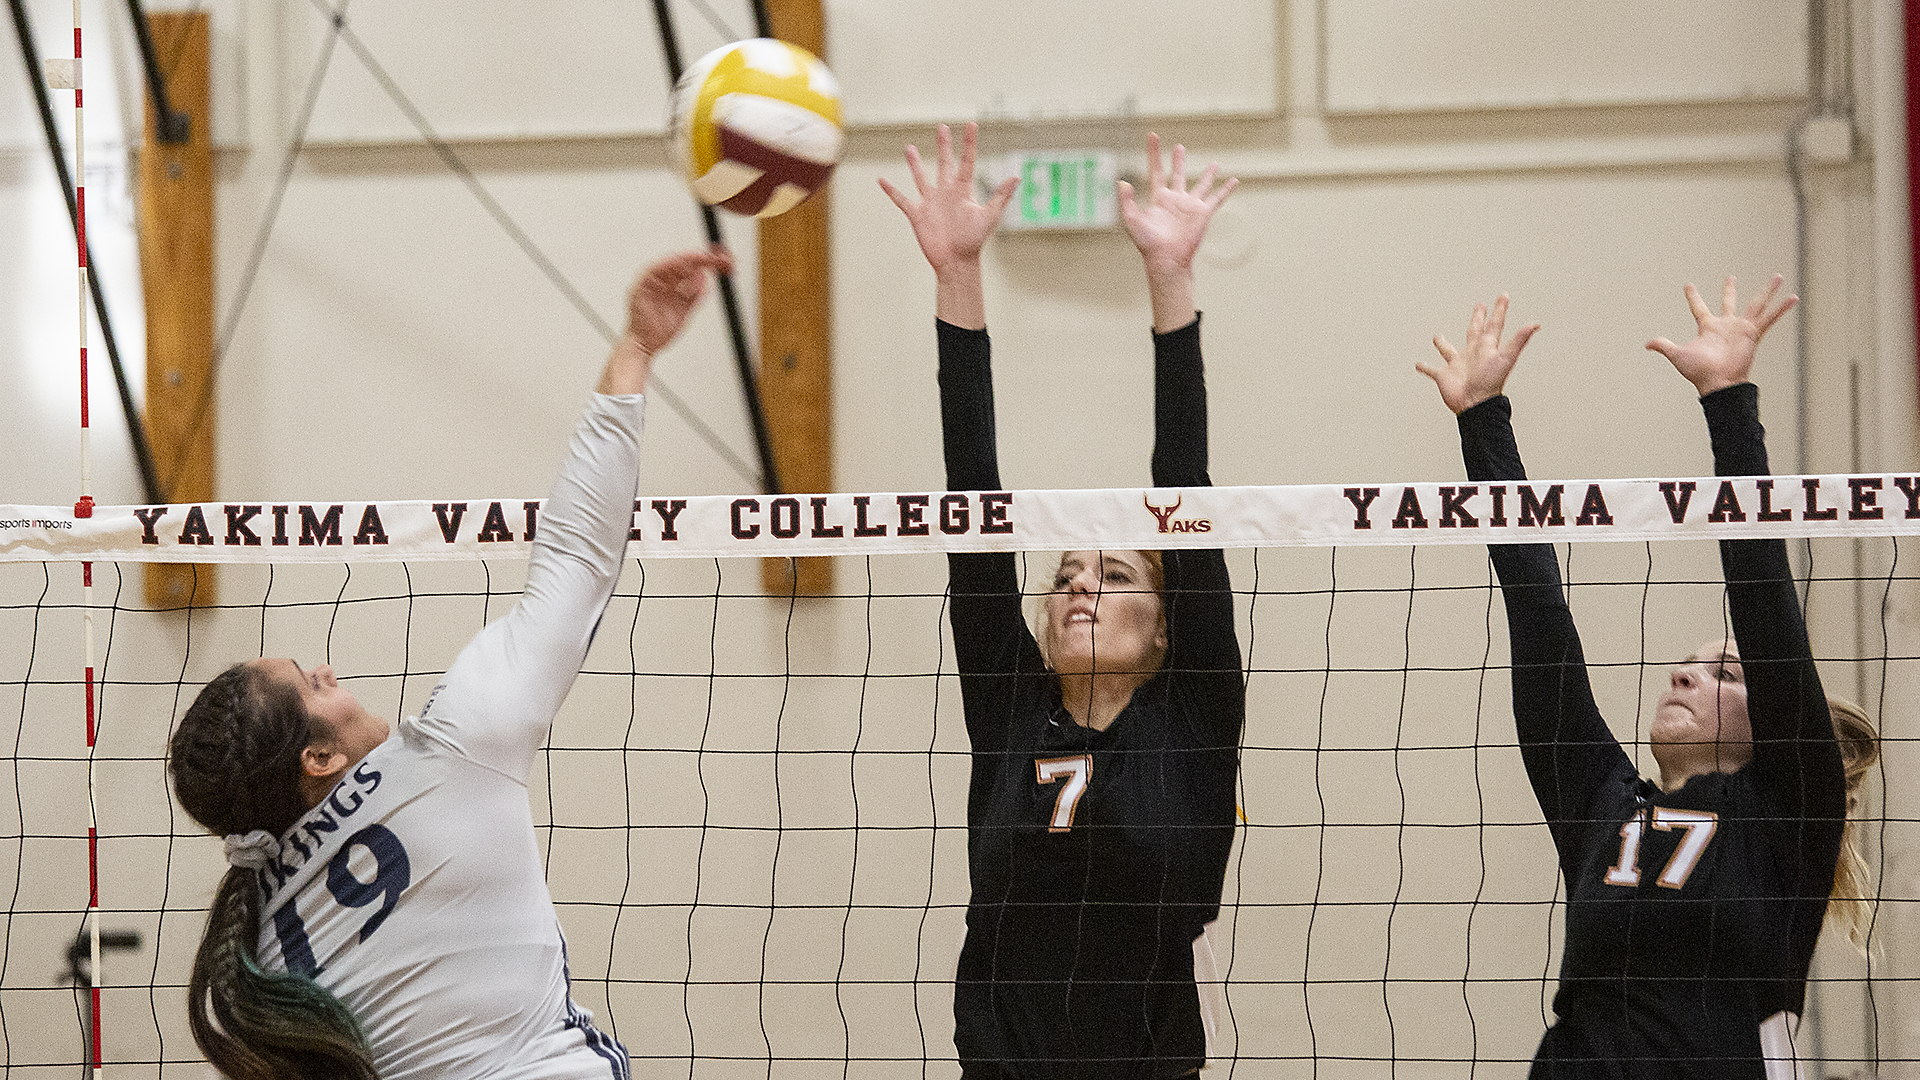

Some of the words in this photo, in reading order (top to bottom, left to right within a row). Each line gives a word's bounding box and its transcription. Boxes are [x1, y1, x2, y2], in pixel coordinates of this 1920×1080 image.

[1021, 158, 1098, 222] EXIT
[0, 518, 30, 531] sports
[32, 518, 73, 531] imports
[133, 504, 389, 546] YAKIMA
[431, 499, 687, 544] VALY
[729, 492, 1014, 540] COLLEGE
[1143, 490, 1213, 535] YAKS
[1343, 483, 1614, 530] YAKIMA
[1658, 476, 1920, 525] VALLEY
[1034, 753, 1094, 834] 7
[258, 761, 383, 906] IKINGS
[1603, 804, 1720, 891] 17
[273, 822, 412, 980] 19
